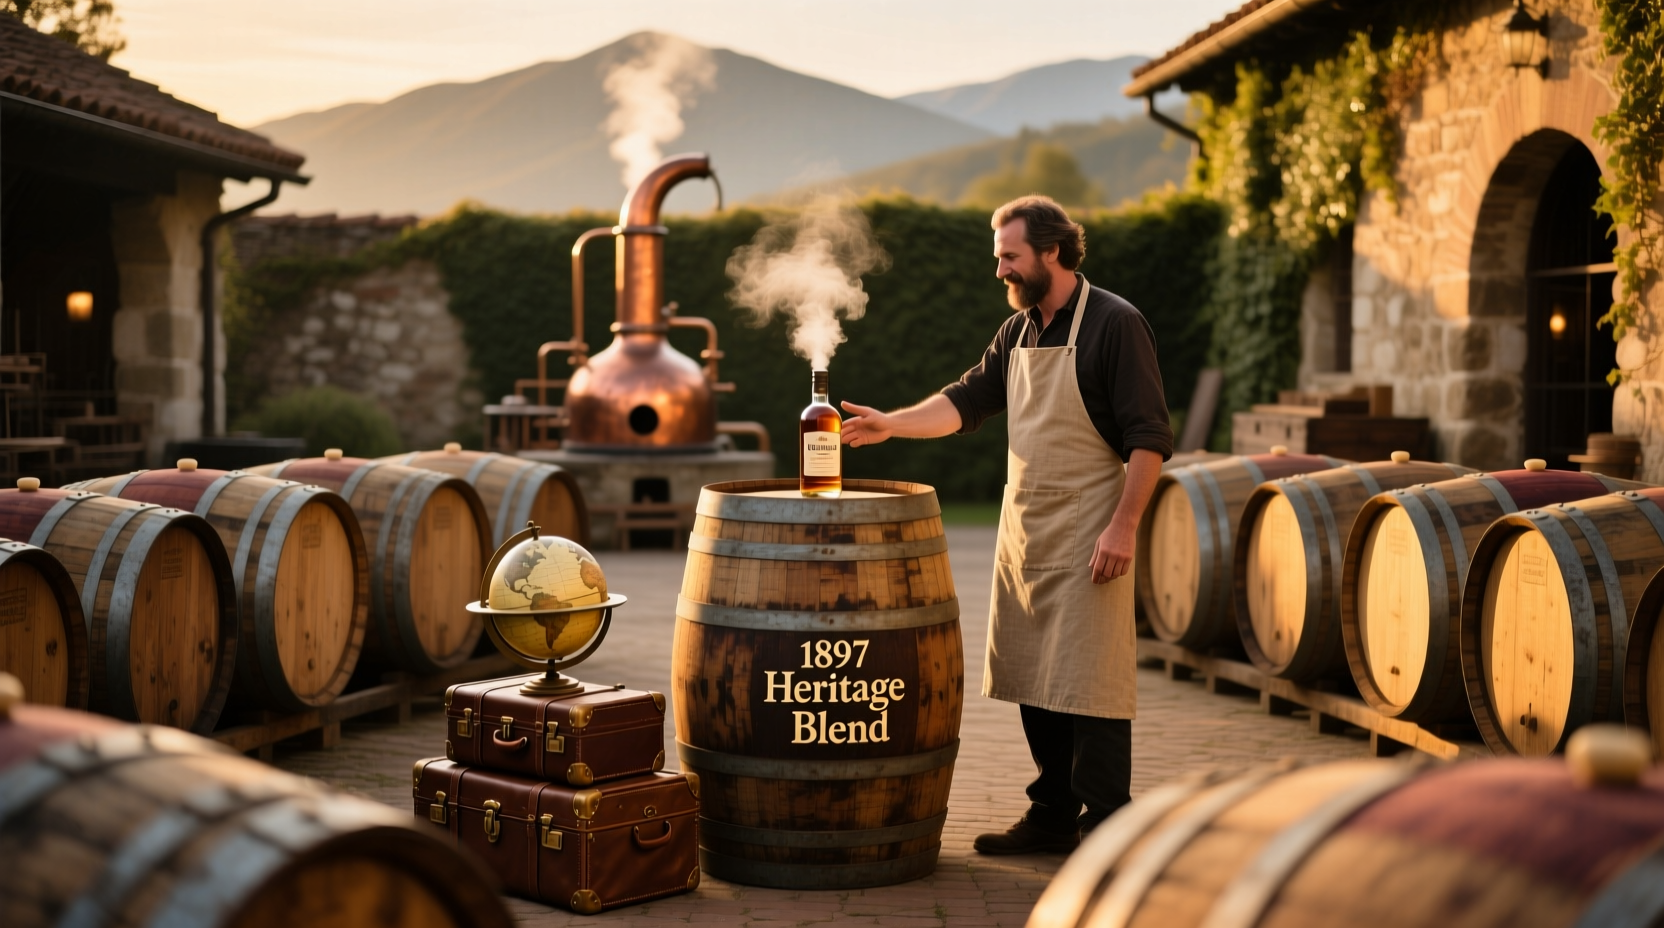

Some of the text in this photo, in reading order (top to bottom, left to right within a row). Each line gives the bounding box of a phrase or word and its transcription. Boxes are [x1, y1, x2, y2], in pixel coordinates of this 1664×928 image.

[800, 639, 870, 669] 1897
[763, 670, 905, 711] Heritage
[791, 709, 890, 744] Blend
